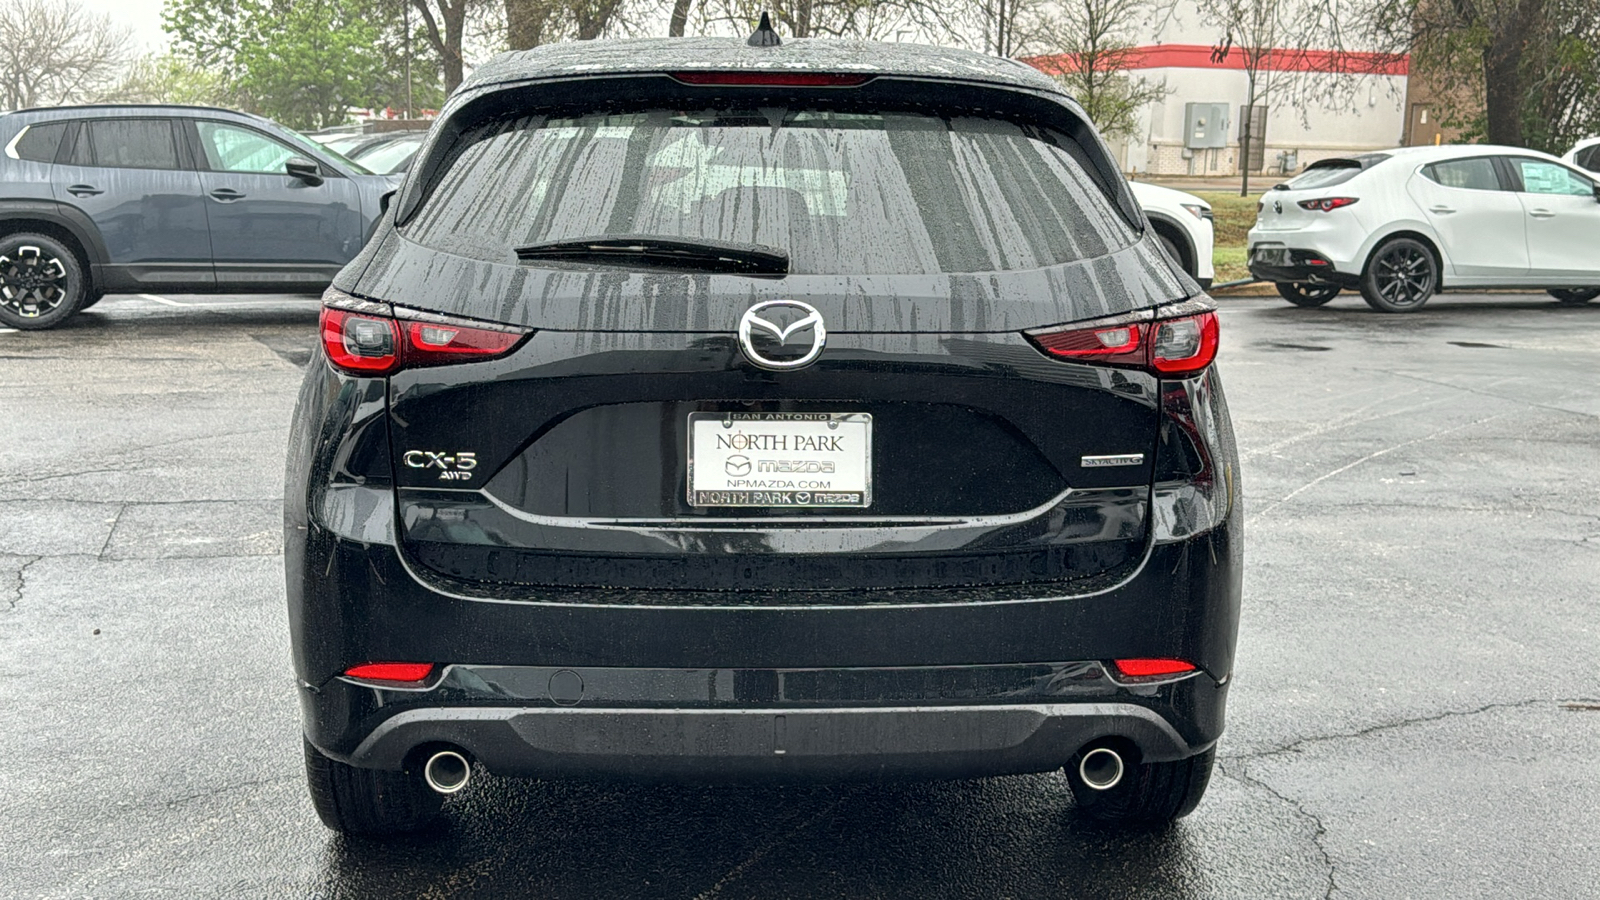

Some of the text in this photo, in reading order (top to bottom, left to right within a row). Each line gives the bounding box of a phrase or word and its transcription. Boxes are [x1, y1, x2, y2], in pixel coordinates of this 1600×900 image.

[716, 432, 844, 451] NORTH PARK
[402, 450, 477, 470] CX-5
[438, 471, 472, 480] AWD
[727, 479, 831, 489] NPMAZDA.COM
[699, 491, 749, 504] NORTH
[752, 492, 792, 504] PARK
